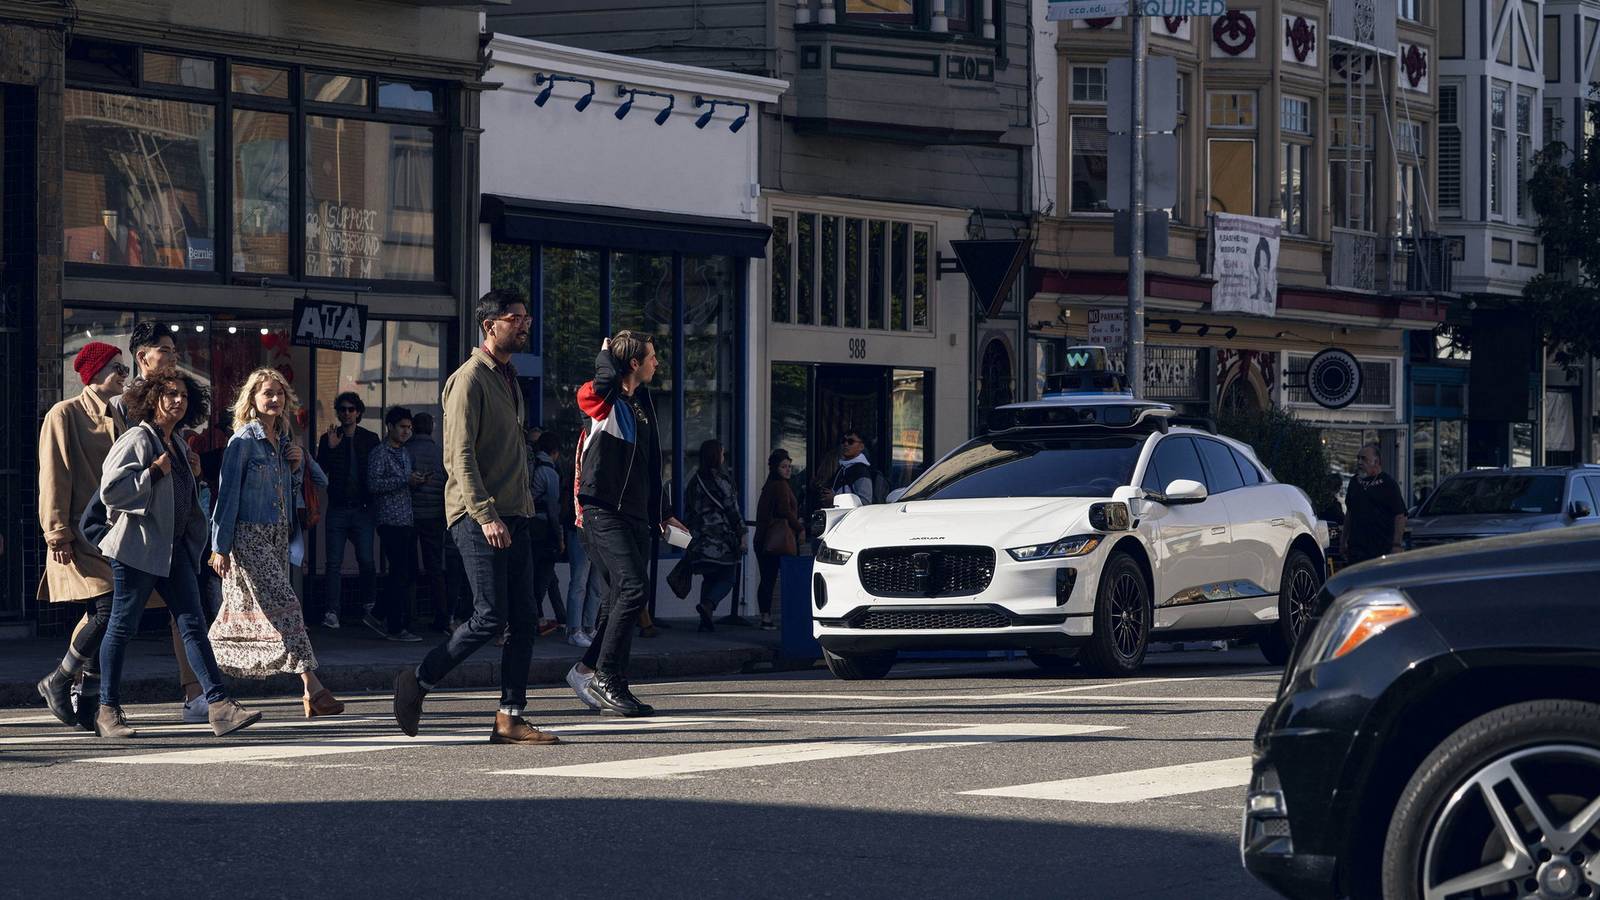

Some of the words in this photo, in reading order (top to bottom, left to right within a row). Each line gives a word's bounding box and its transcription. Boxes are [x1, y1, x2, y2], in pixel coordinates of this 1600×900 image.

[1068, 6, 1107, 15] cca.edu
[1143, 0, 1225, 17] QUIRED
[326, 205, 378, 231] SUPPORT
[188, 246, 214, 259] Bernie
[296, 303, 362, 342] ATA
[1088, 310, 1099, 322] NO
[1100, 312, 1123, 321] PARKING
[849, 337, 866, 359] 988
